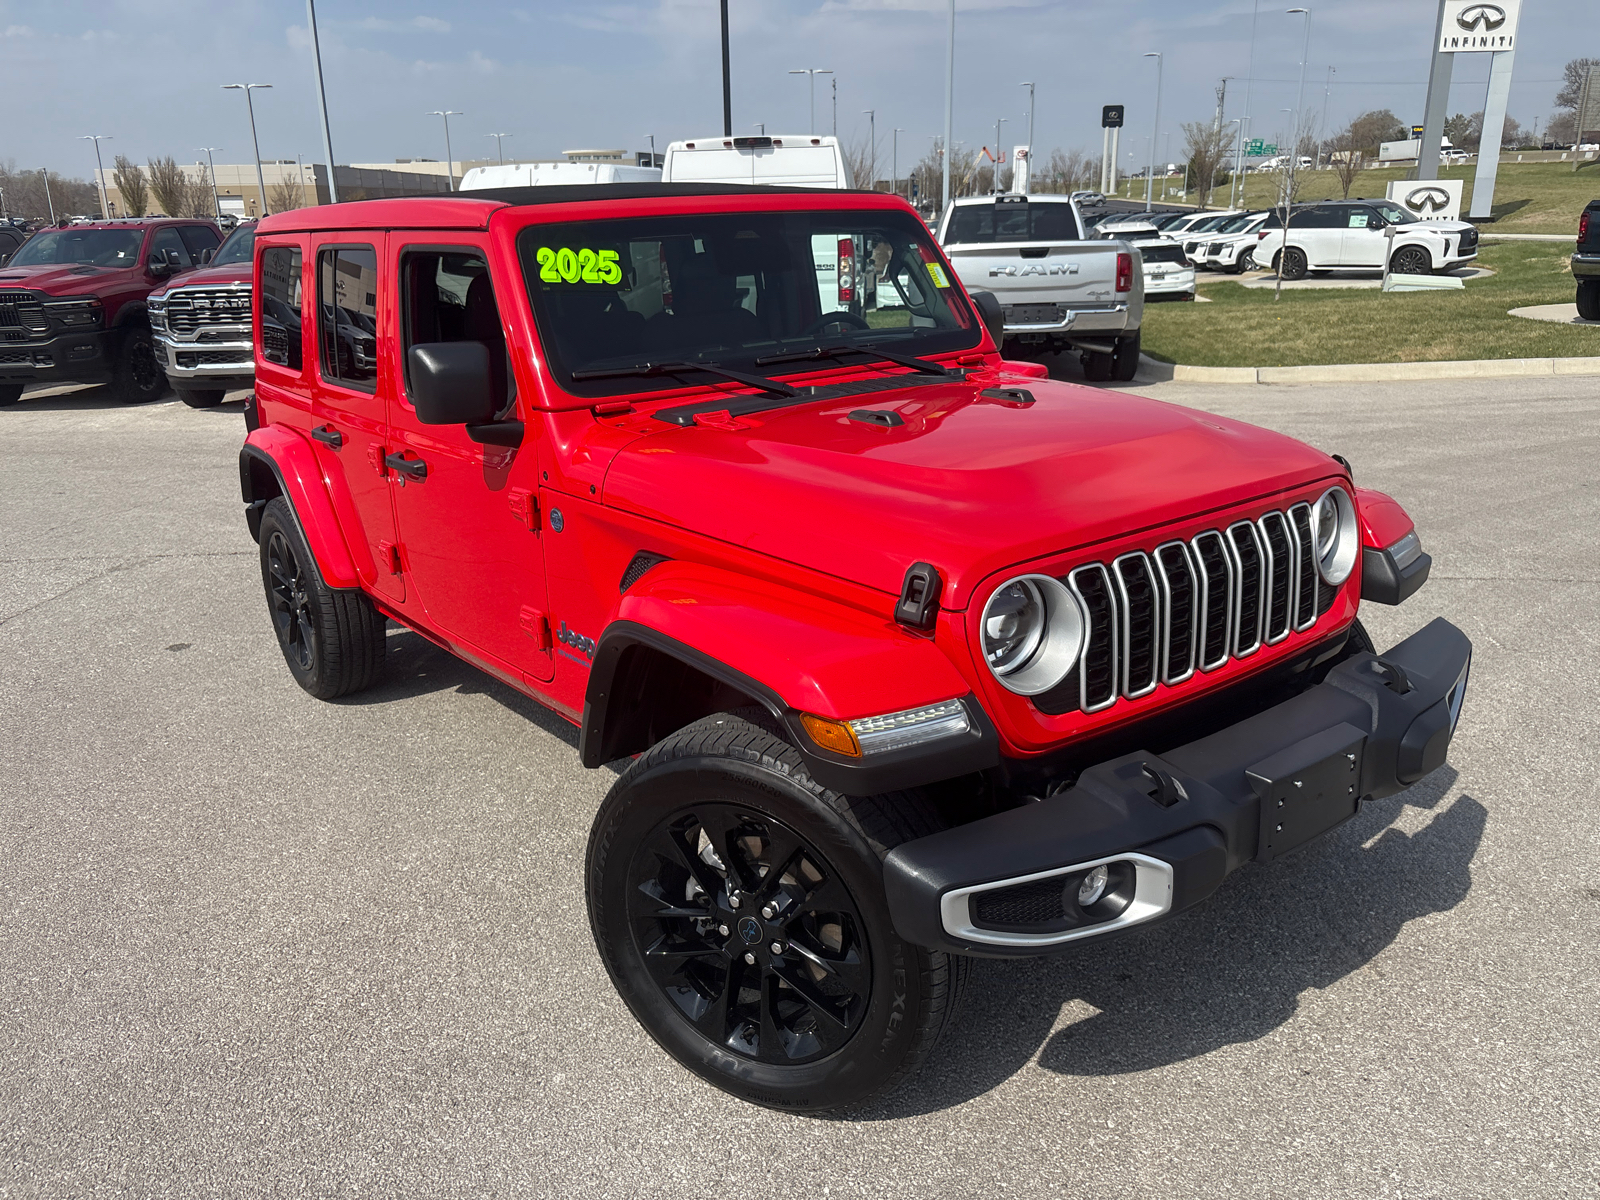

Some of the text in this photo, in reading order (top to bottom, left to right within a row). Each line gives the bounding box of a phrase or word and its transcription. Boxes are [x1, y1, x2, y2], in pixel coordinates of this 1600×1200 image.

[1443, 35, 1513, 48] INFINITI
[536, 247, 622, 285] 2025
[989, 263, 1079, 277] RAM
[193, 298, 250, 309] RAM
[556, 620, 596, 660] Jeep
[721, 771, 782, 798] 255/60R20
[881, 943, 907, 1049] NEXEN
